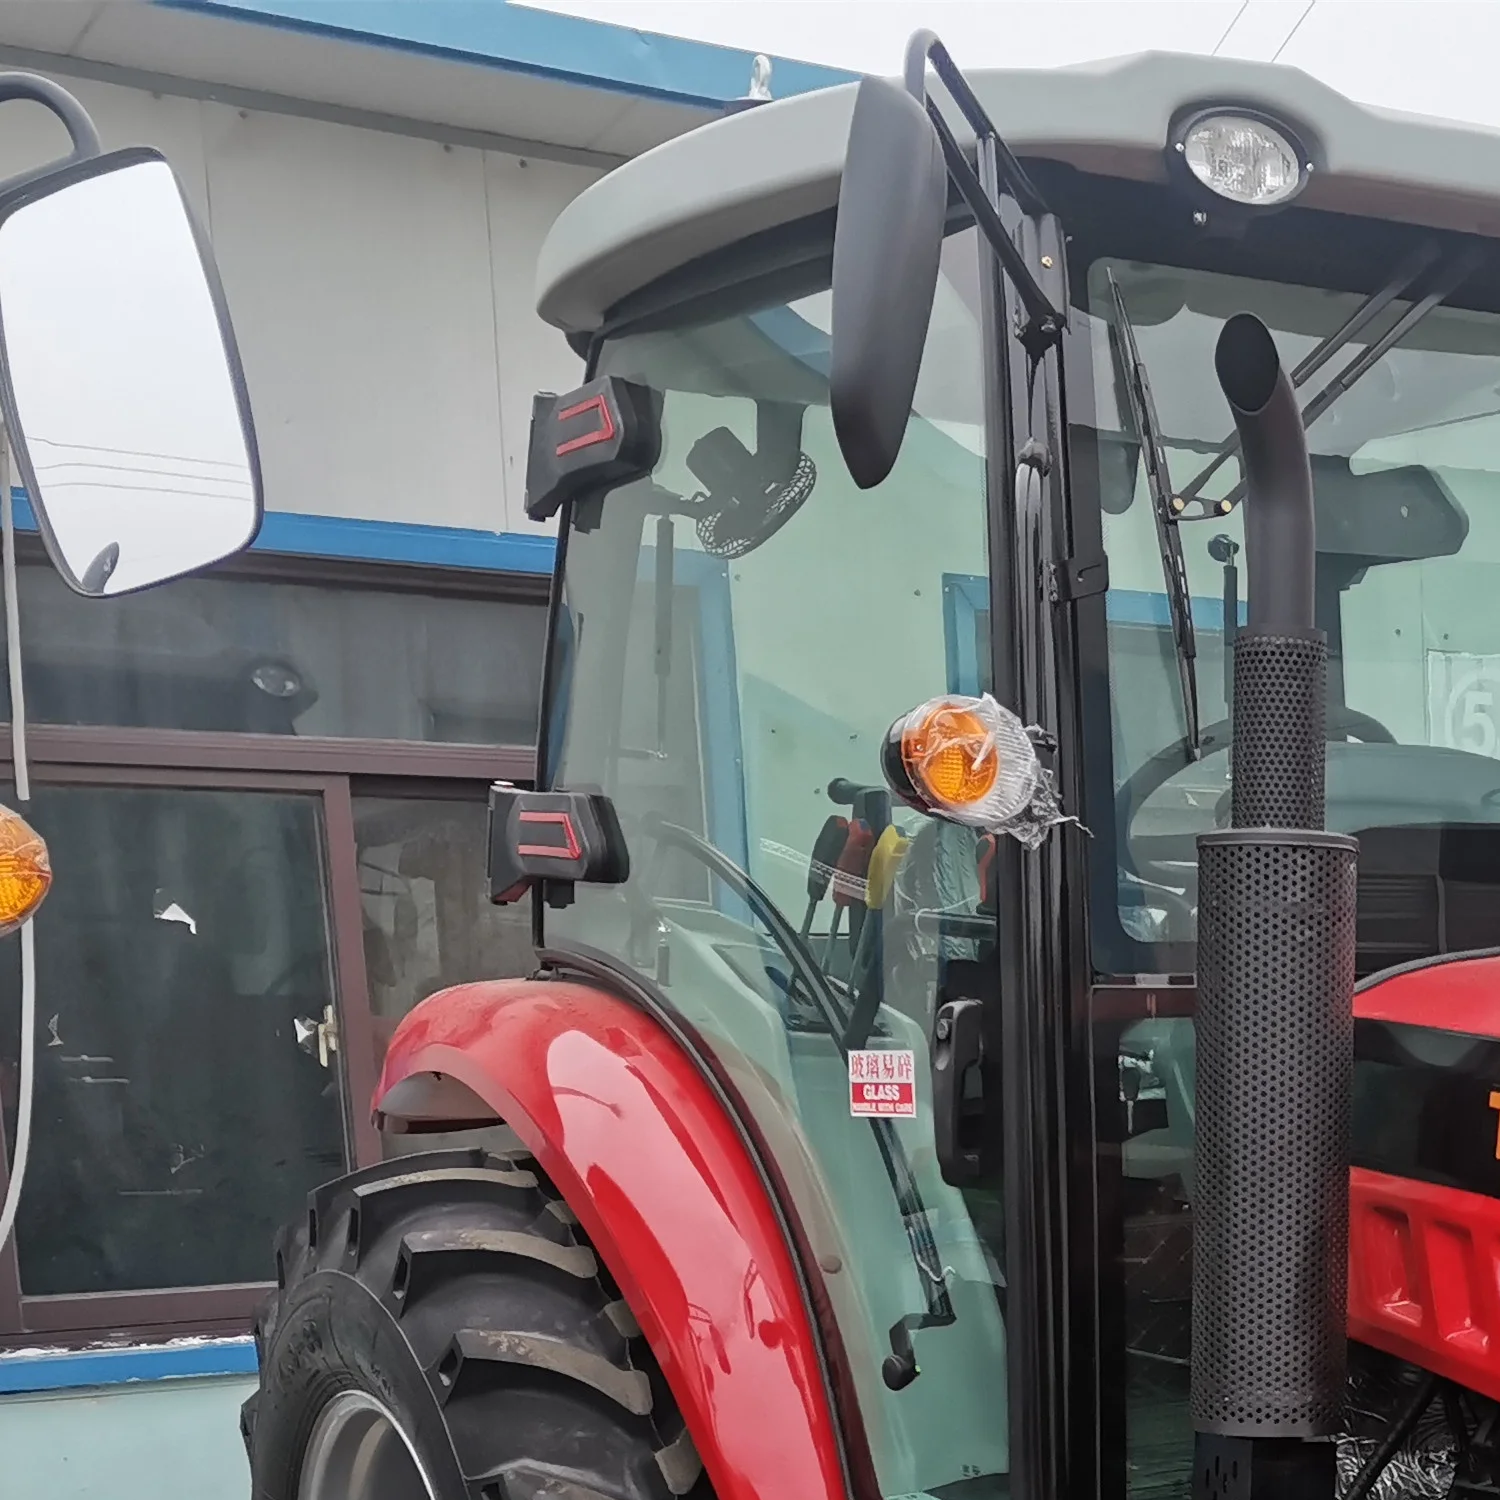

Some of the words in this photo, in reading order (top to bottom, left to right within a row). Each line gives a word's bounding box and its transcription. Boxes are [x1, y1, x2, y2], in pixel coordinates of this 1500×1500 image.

[852, 1053, 912, 1080] 玻璃易碎
[863, 1084, 900, 1101] GLASS
